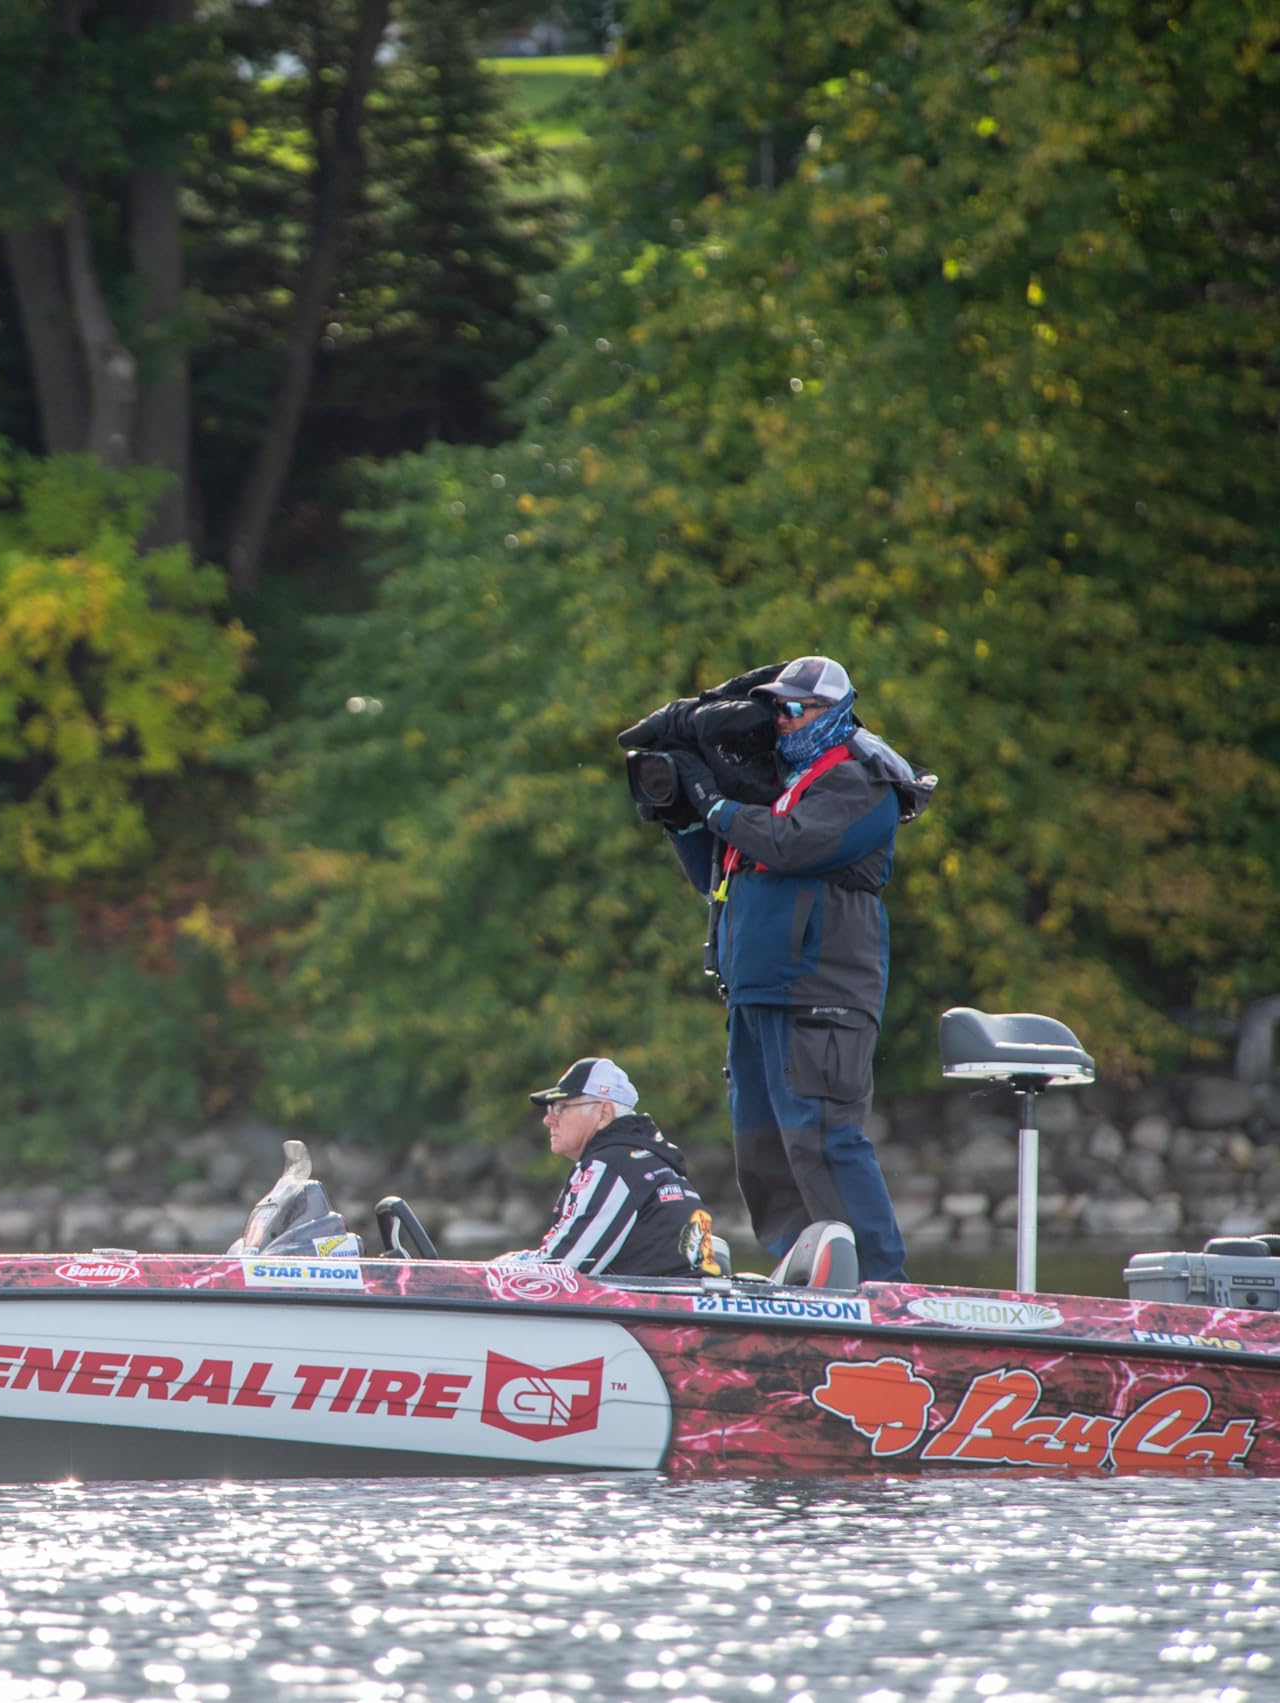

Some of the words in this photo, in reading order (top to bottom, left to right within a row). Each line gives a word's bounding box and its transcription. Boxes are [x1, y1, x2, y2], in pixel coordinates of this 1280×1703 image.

[65, 1264, 132, 1281] Berkley
[252, 1265, 303, 1279] STAR
[307, 1266, 360, 1281] TRON
[722, 1296, 863, 1322] FERGUSON
[291, 1364, 472, 1419] TIRE
